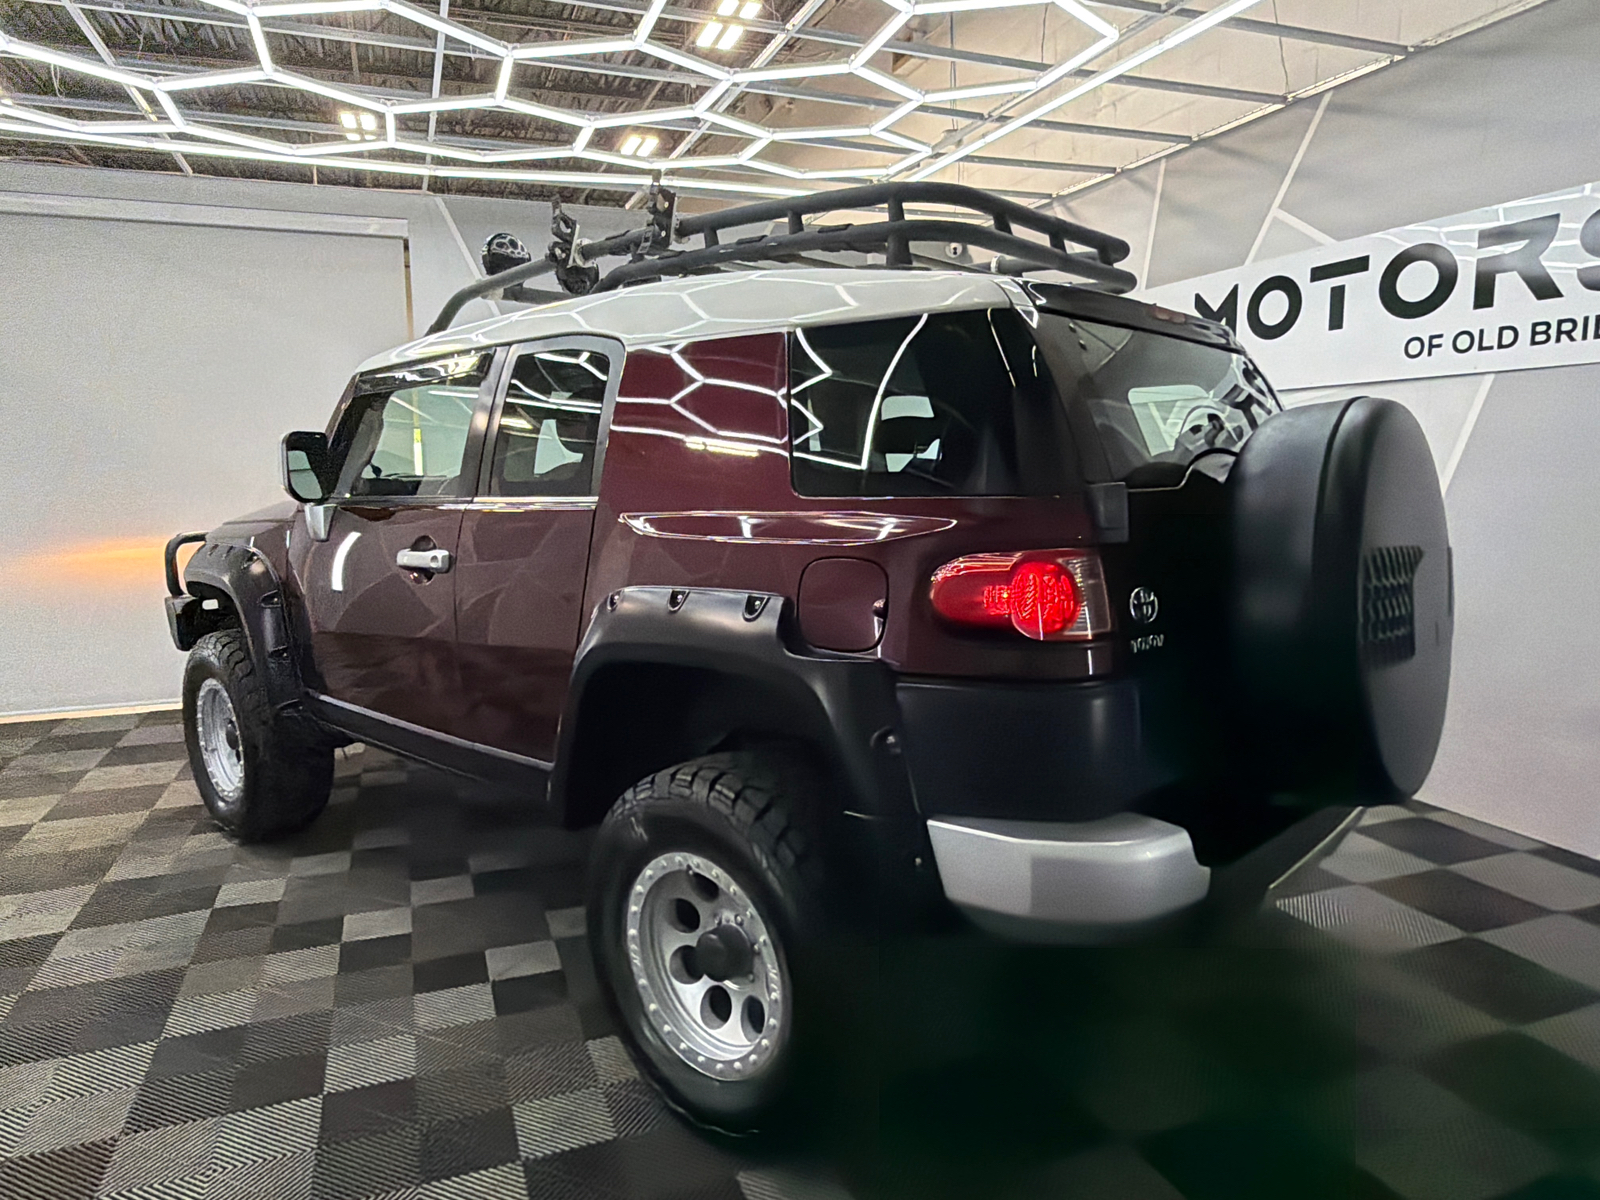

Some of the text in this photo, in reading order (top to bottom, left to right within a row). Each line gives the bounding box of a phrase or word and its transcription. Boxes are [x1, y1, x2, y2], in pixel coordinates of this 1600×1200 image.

[1403, 314, 1600, 359] OF OLD BRI
